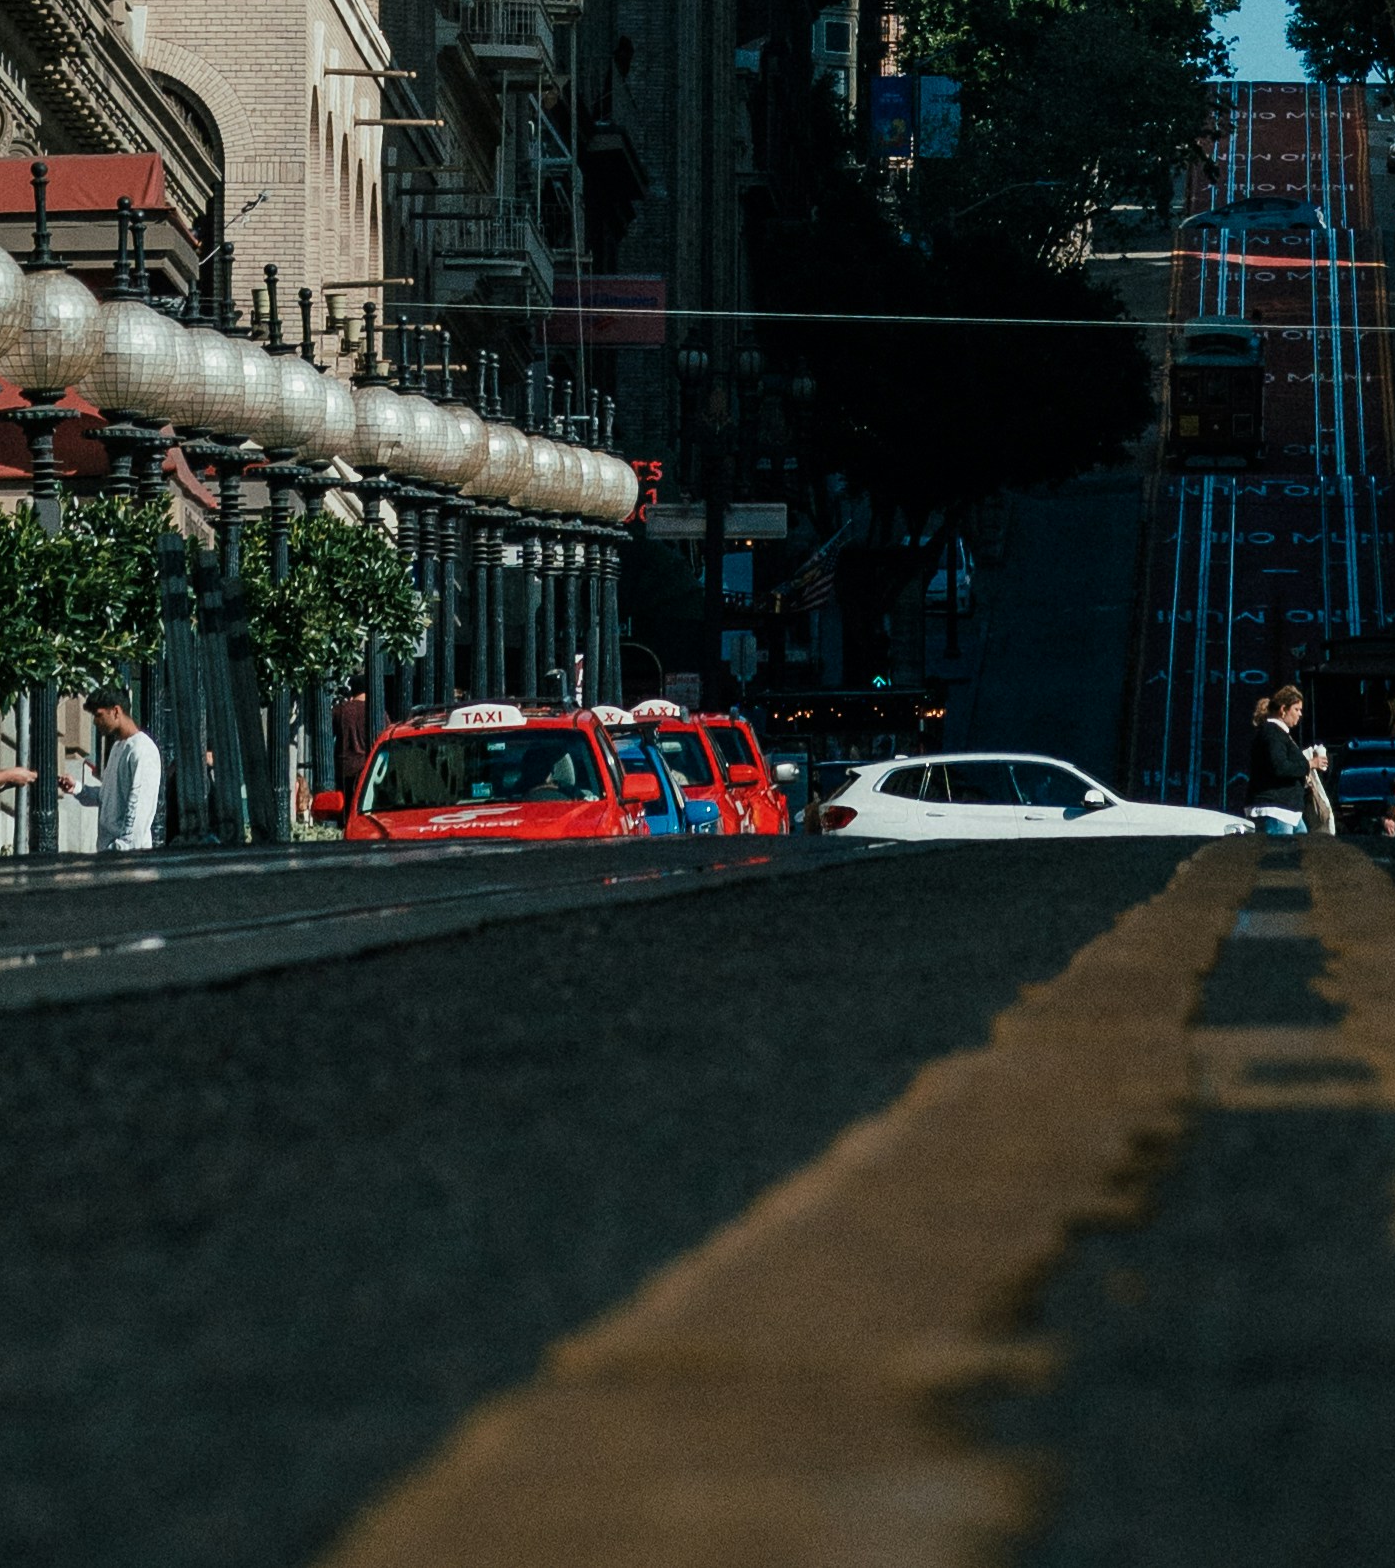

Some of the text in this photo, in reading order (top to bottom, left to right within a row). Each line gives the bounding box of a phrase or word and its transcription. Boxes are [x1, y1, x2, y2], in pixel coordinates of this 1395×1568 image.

[461, 710, 503, 725] TAXI
[604, 712, 624, 725] XI
[417, 818, 526, 834] Flywheel
